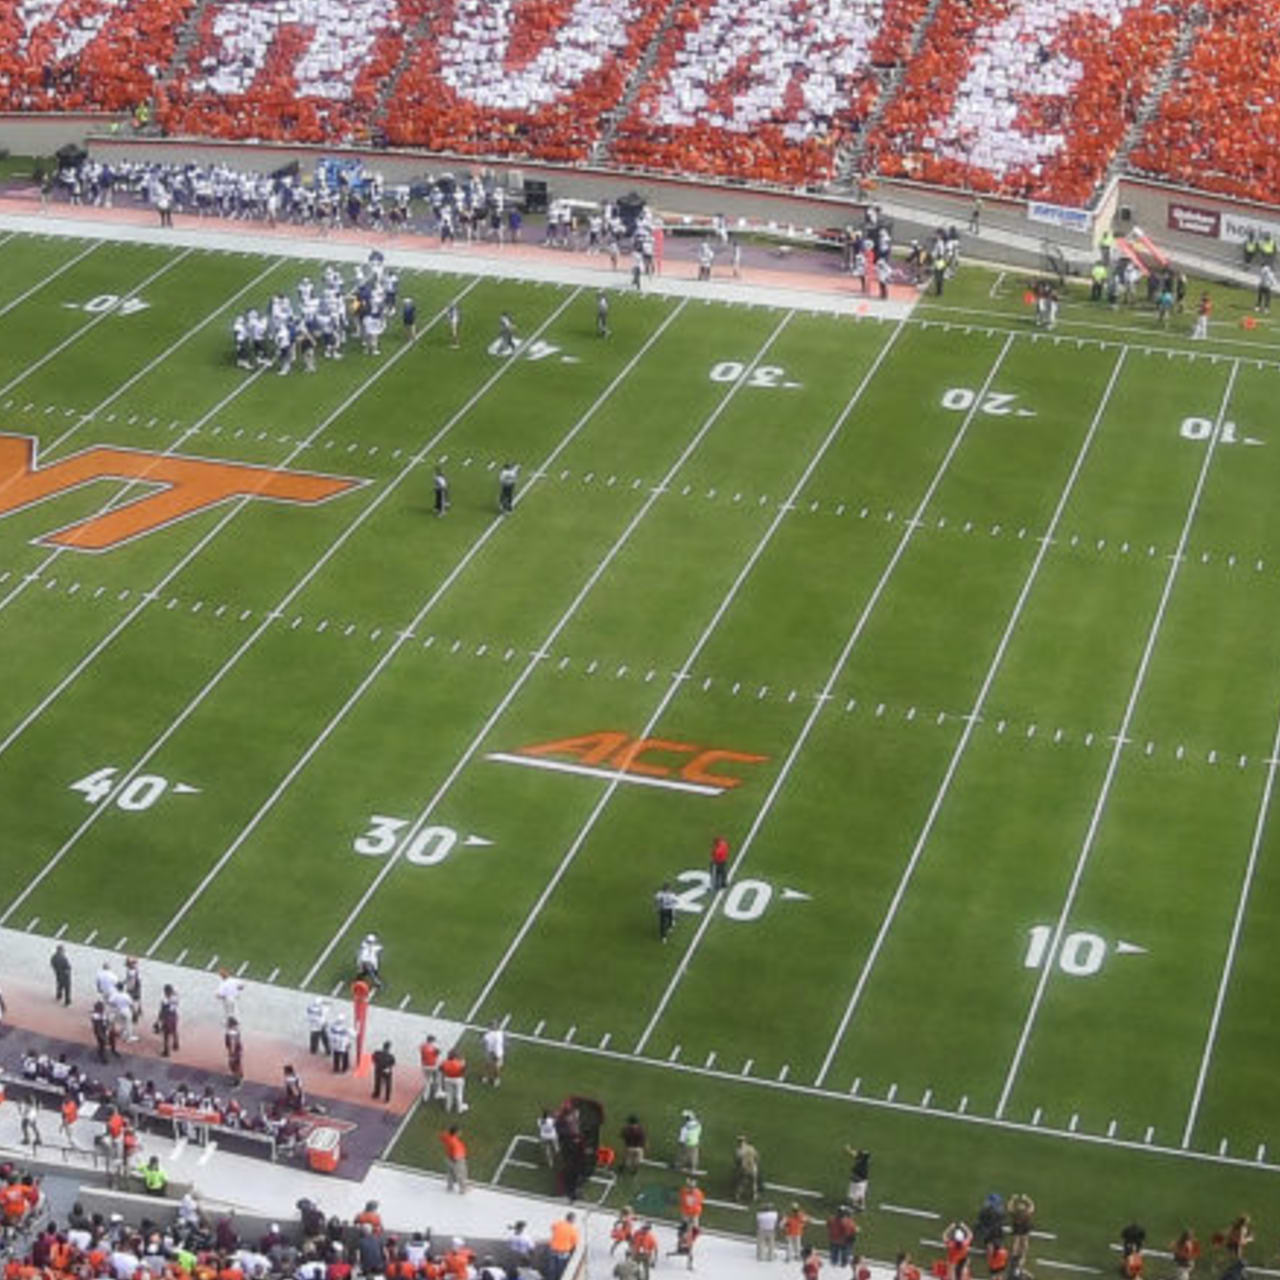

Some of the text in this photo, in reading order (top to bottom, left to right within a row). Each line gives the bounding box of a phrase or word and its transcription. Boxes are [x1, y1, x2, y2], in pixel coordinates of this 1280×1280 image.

[709, 361, 785, 388] 30
[940, 387, 1019, 415] 20
[1179, 415, 1239, 445] 10
[517, 729, 772, 792] ACC
[70, 766, 168, 812] 40
[353, 814, 458, 867] 30
[670, 869, 774, 922] 20
[1024, 924, 1107, 976] 10
